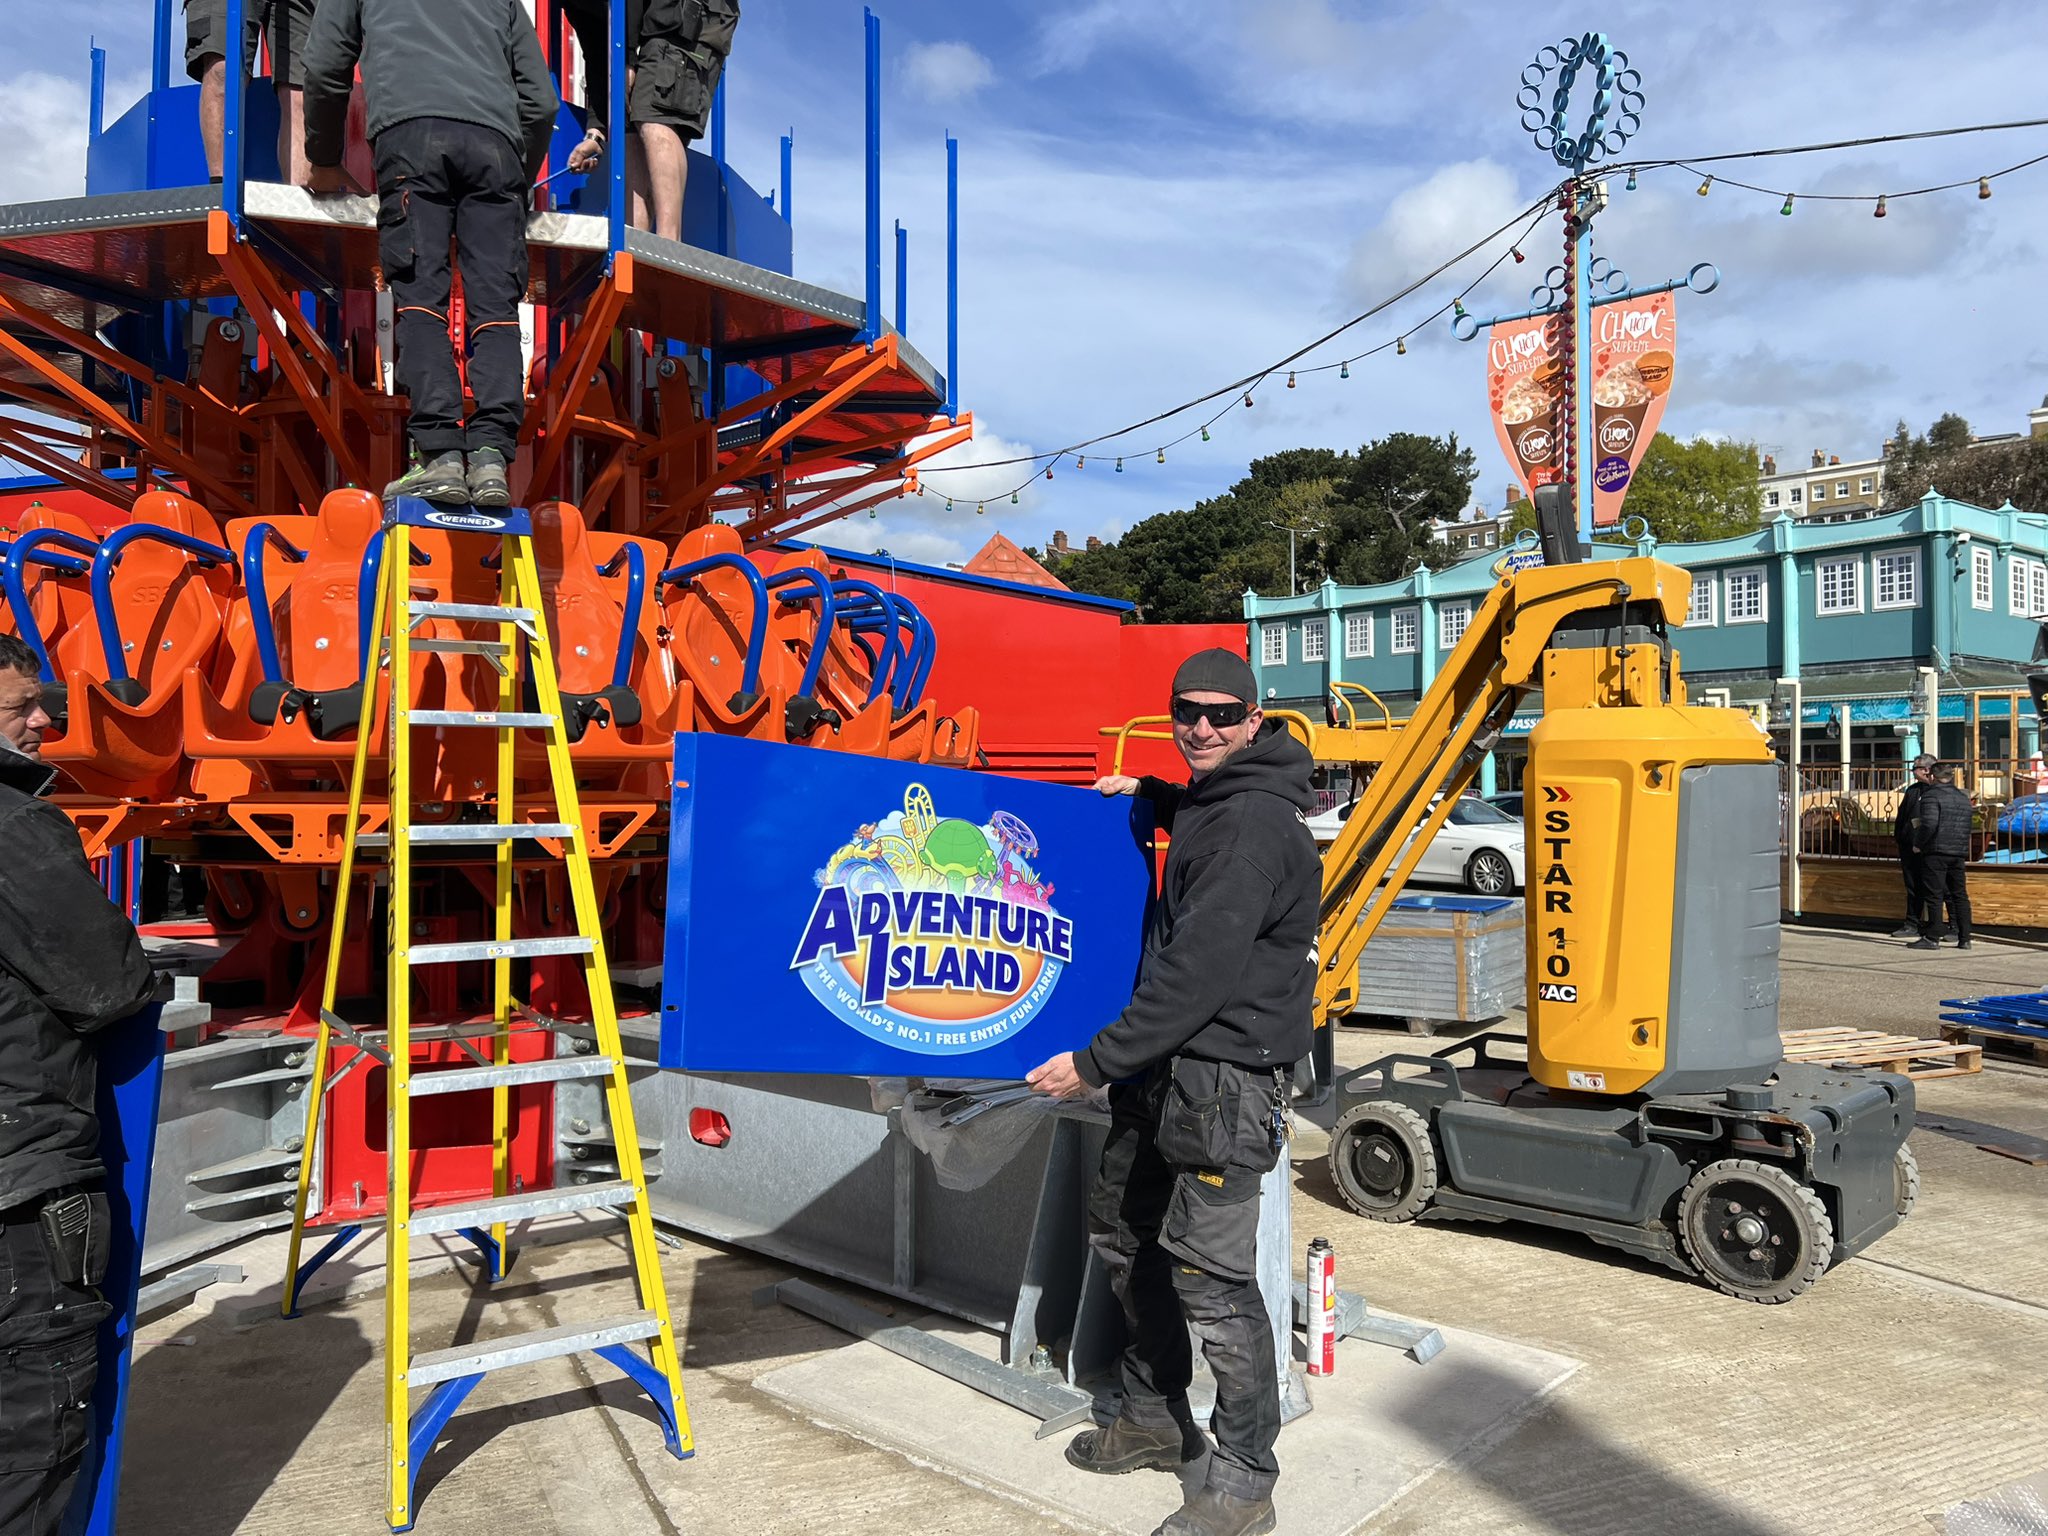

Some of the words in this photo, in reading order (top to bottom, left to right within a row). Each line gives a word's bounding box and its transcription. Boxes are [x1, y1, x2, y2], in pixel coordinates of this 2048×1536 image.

[1629, 317, 1648, 332] HOT
[1519, 335, 1536, 353] HOT
[1611, 341, 1650, 353] SUPREME
[1508, 355, 1545, 376] SUPREME
[441, 515, 490, 526] WERNER
[1508, 717, 1541, 730] PASS
[1543, 810, 1573, 913] STAR
[791, 885, 1072, 966] ADVENTURE
[1547, 927, 1570, 978] 10
[863, 933, 1021, 1003] ISLAND
[1546, 984, 1577, 1001] AC
[813, 962, 835, 992] THE
[835, 987, 895, 1034] WORLD'S
[896, 1024, 932, 1045] NO.1
[935, 1031, 968, 1046] FREE
[970, 1020, 1010, 1044] ENTRY
[1009, 1001, 1035, 1026] FUN
[1031, 961, 1059, 1004] PARK!
